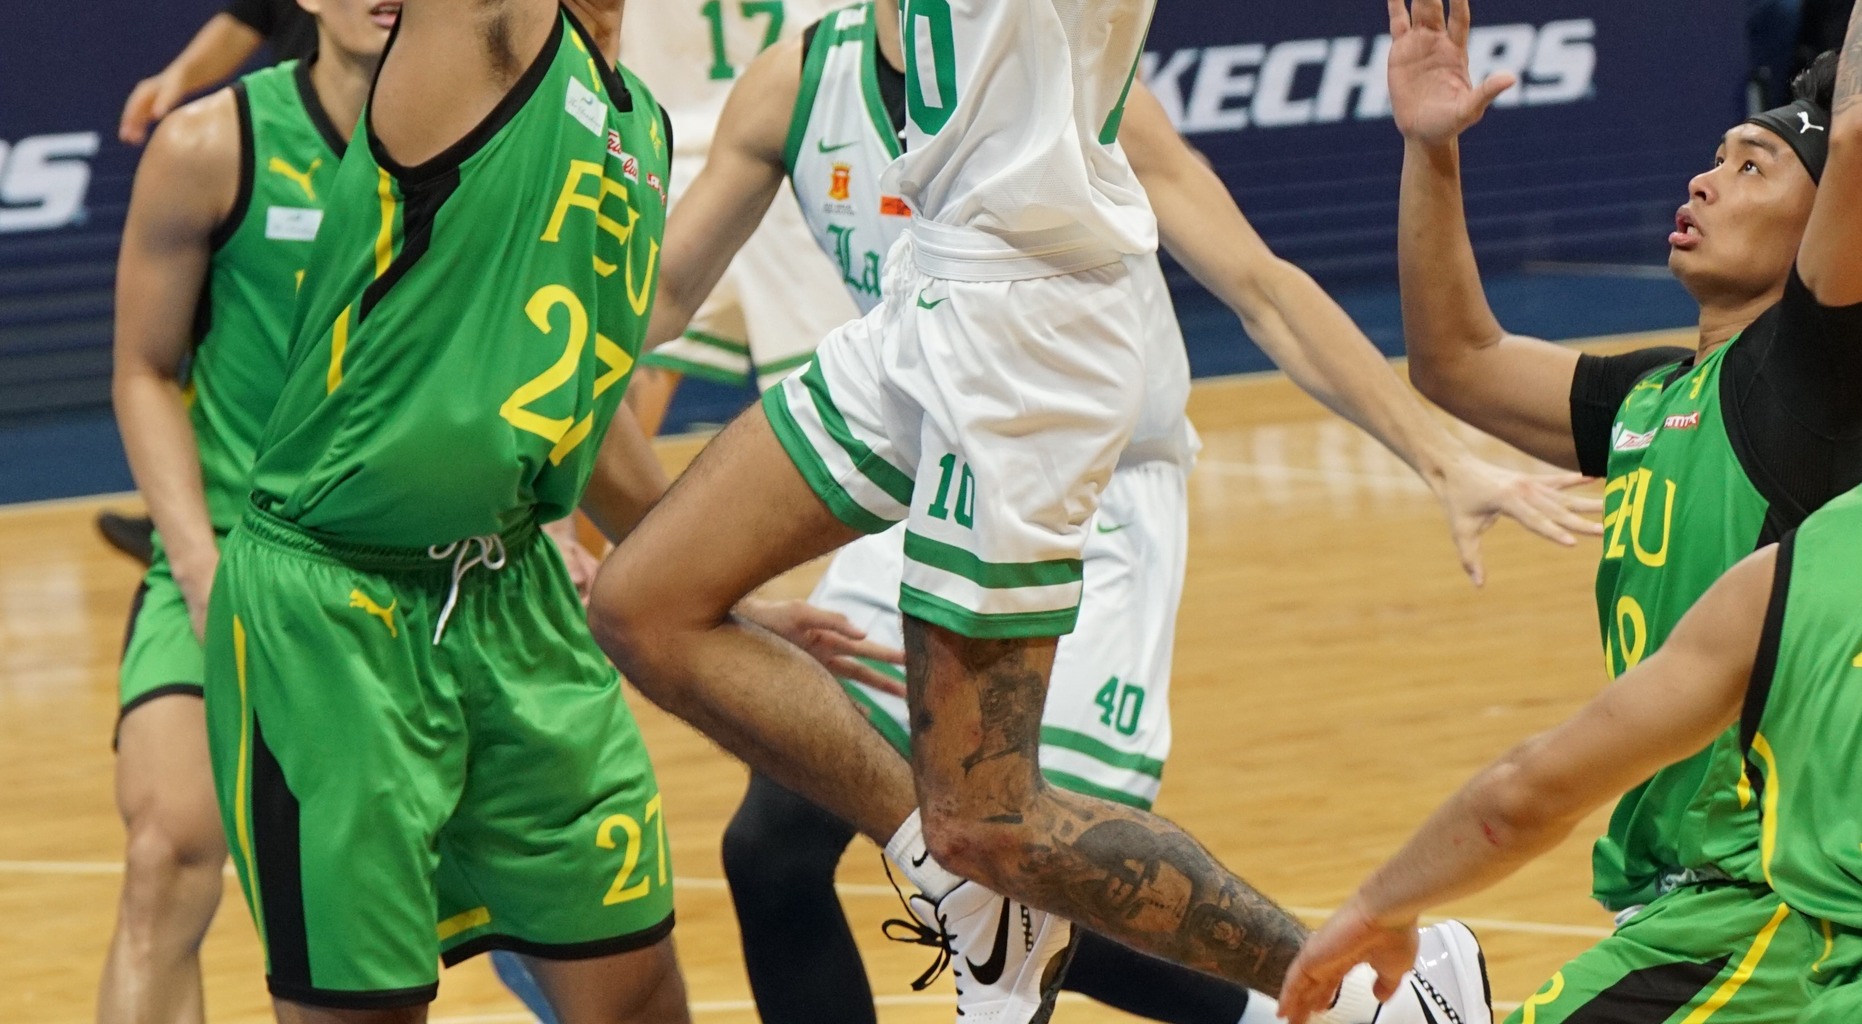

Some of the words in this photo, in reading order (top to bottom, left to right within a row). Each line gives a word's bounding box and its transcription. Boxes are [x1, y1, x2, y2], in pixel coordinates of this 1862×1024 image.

[1142, 18, 1597, 135] KECHRS
[0, 131, 101, 234] S
[540, 159, 660, 318] FEU
[826, 224, 882, 298] La
[499, 284, 634, 467] 27
[927, 452, 975, 531] 10
[1094, 675, 1145, 737] 40
[595, 791, 667, 907] 27
